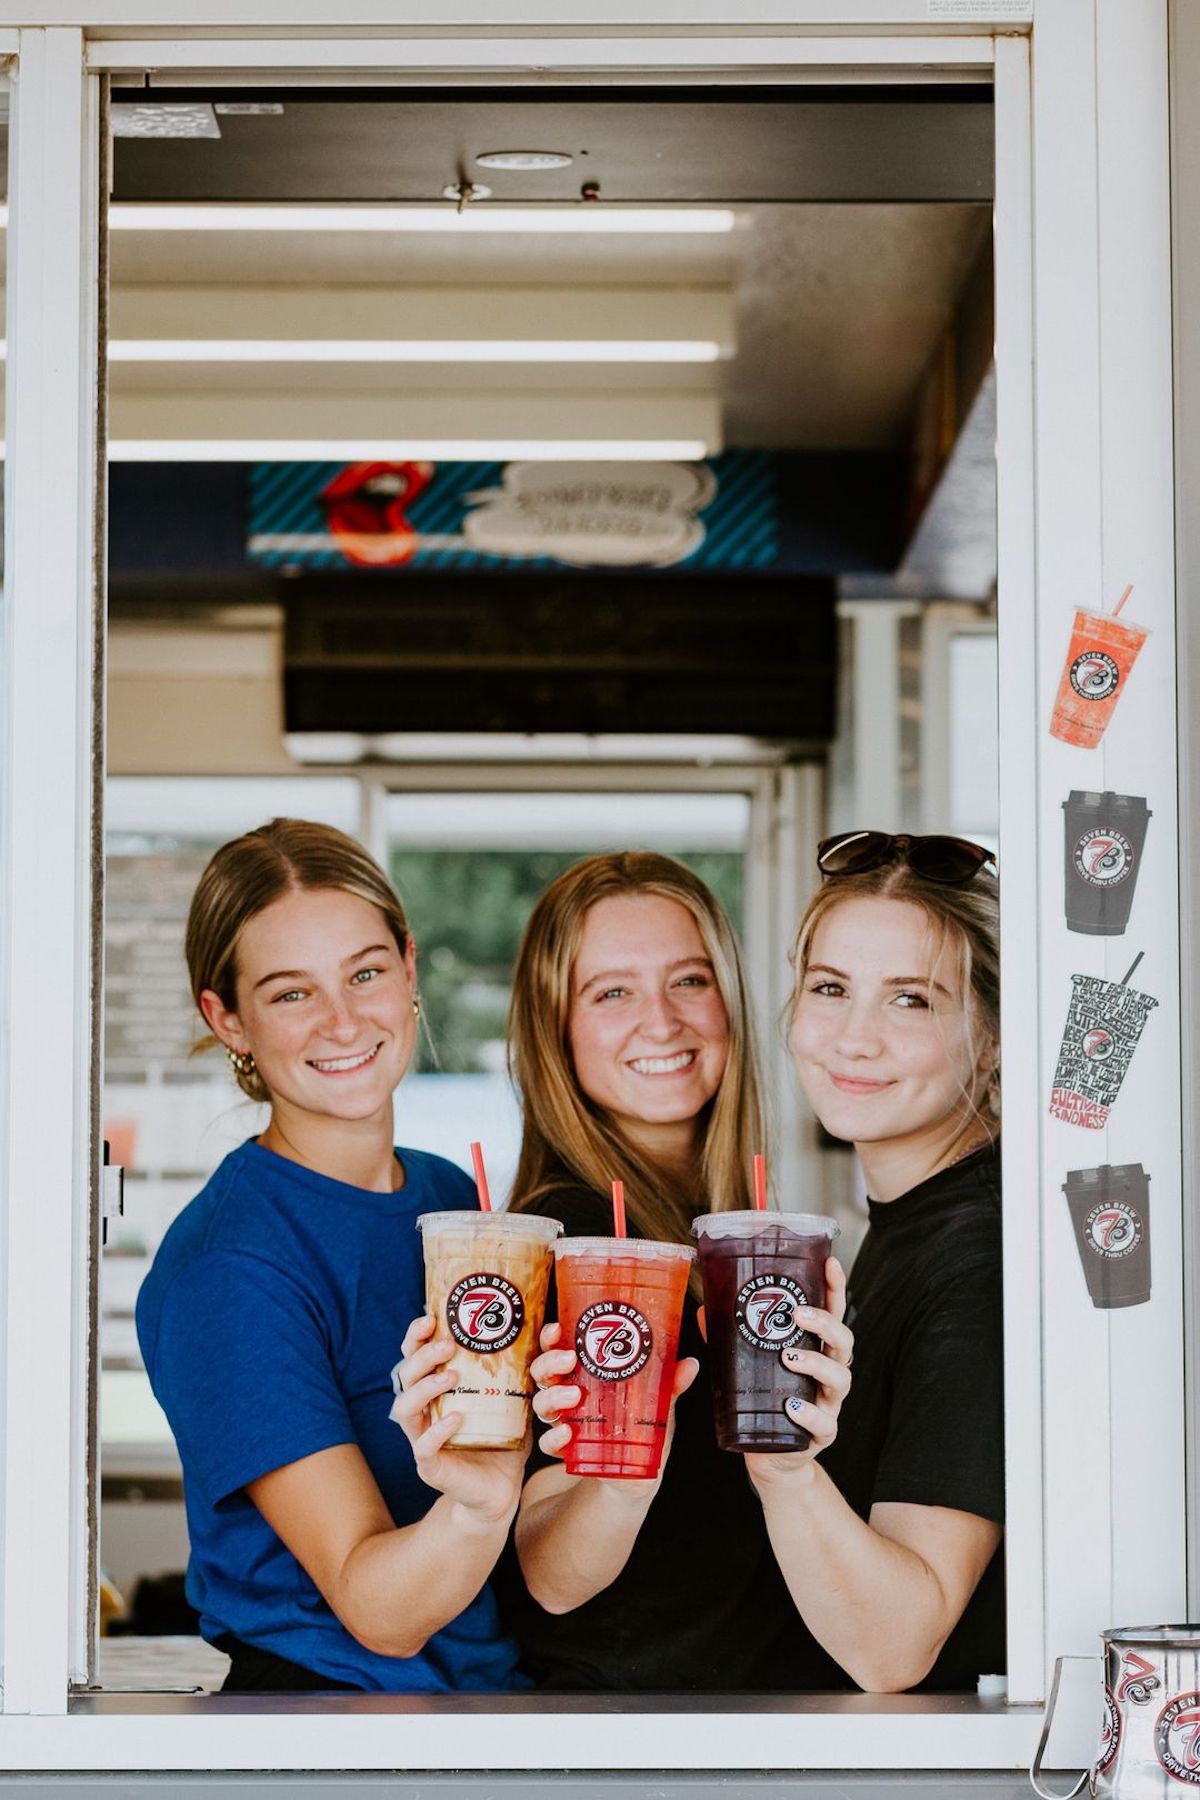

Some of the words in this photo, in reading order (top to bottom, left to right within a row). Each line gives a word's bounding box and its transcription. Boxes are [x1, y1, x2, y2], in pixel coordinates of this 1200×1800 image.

[1078, 652, 1102, 663] SEVEN
[1102, 655, 1118, 675] BREW
[1080, 829, 1107, 847] SEVEN
[1109, 830, 1130, 850] BREW
[1108, 866, 1130, 885] COFFEE
[1070, 974, 1108, 991] START
[1051, 1089, 1111, 1116] CULTIVATE
[1100, 1092, 1118, 1107] UP
[1049, 1105, 1108, 1130] KINDNESS
[1087, 1202, 1111, 1223] SEVEN
[1113, 1202, 1136, 1218] BREW
[1122, 1234, 1141, 1255] COFFEE
[451, 1276, 487, 1303] SEVEN
[492, 1277, 521, 1305] BREW
[738, 1276, 775, 1303] SEVEN
[579, 1303, 613, 1330] SEVEN
[619, 1304, 650, 1333] BREW
[452, 1322, 470, 1345] DRIVE
[470, 1341, 492, 1350] THRU
[493, 1325, 519, 1349] COFFEE
[739, 1323, 758, 1345] DRIVE
[759, 1341, 781, 1350] THRU
[782, 1328, 804, 1349] COFFE
[579, 1350, 597, 1373] DRIVE
[597, 1369, 619, 1379] THRU
[620, 1353, 648, 1378] COFFEE
[1161, 1696, 1196, 1729] SEVEN
[1103, 1735, 1119, 1763] DRIVE
[1162, 1752, 1188, 1777] DRIVE
